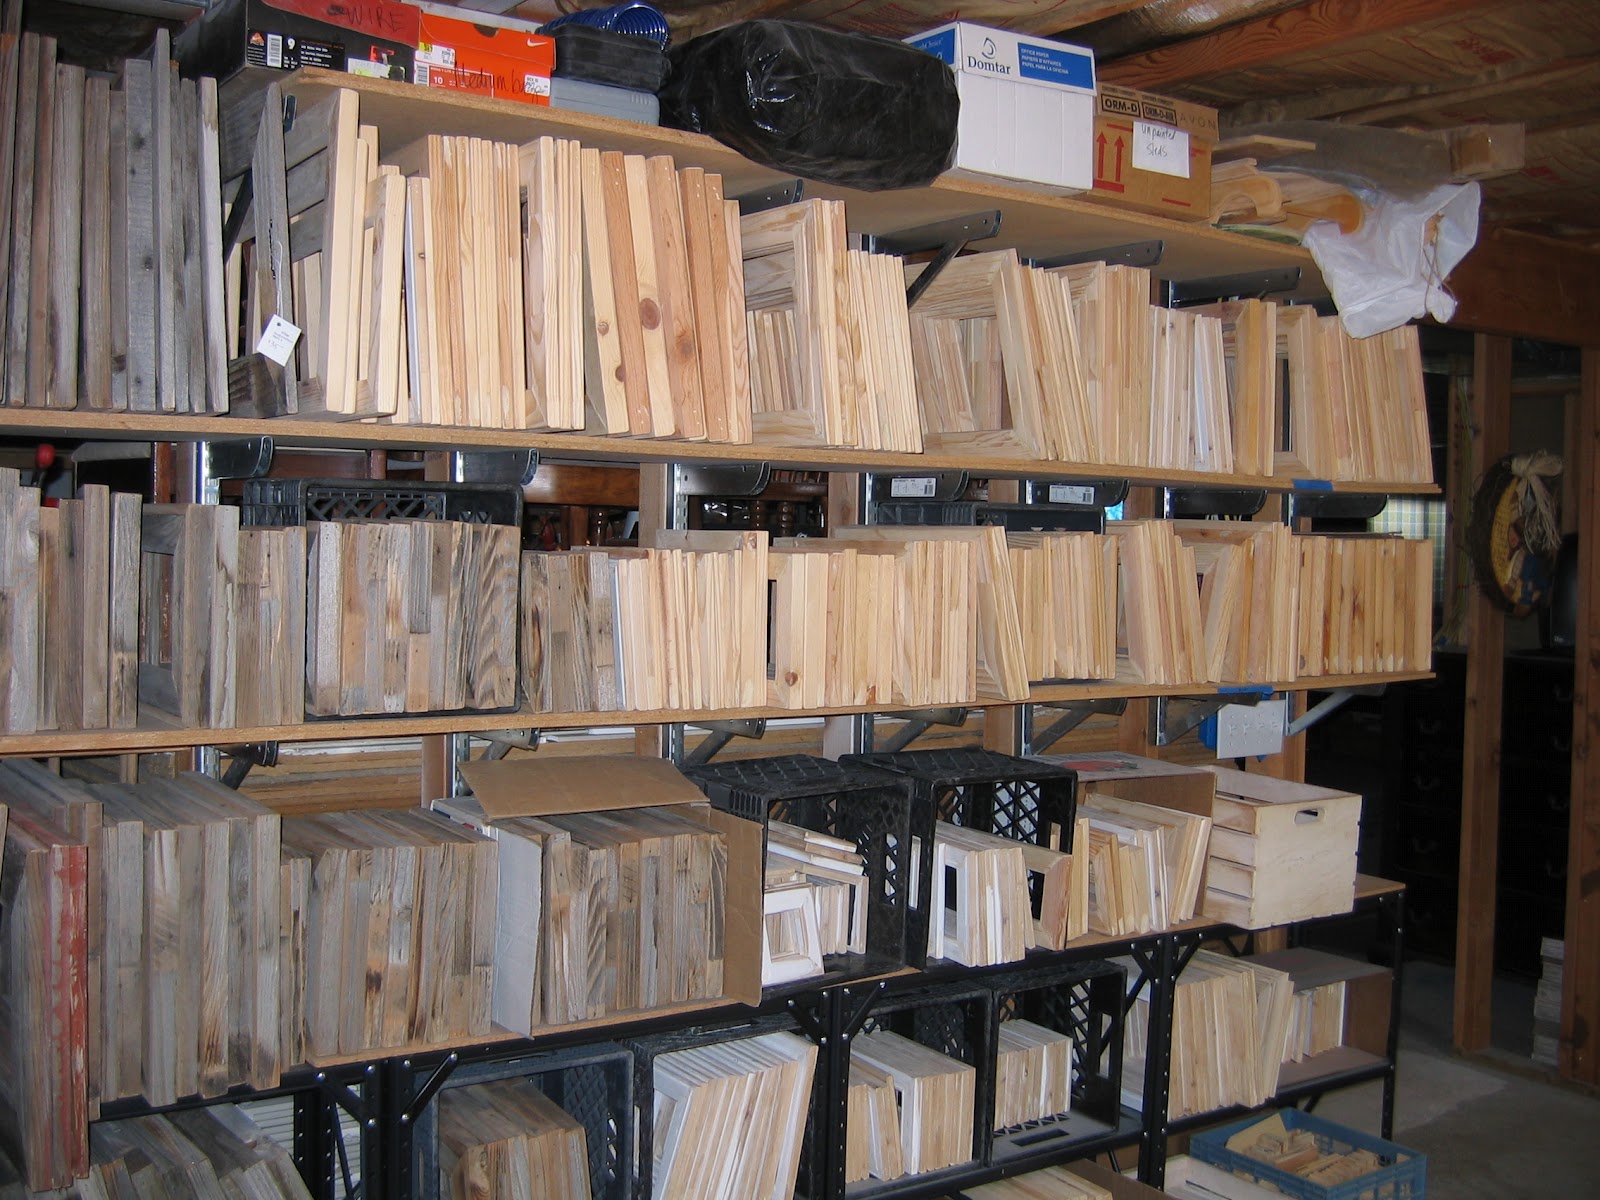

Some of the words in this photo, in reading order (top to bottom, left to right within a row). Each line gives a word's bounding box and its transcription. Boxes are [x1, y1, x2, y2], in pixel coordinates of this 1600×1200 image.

[346, 6, 404, 31] WIRE
[287, 38, 296, 50] 9
[967, 55, 1011, 75] Domtar
[433, 76, 443, 85] 10
[1105, 98, 1138, 112] ORM-D
[1179, 112, 1216, 130] AVON
